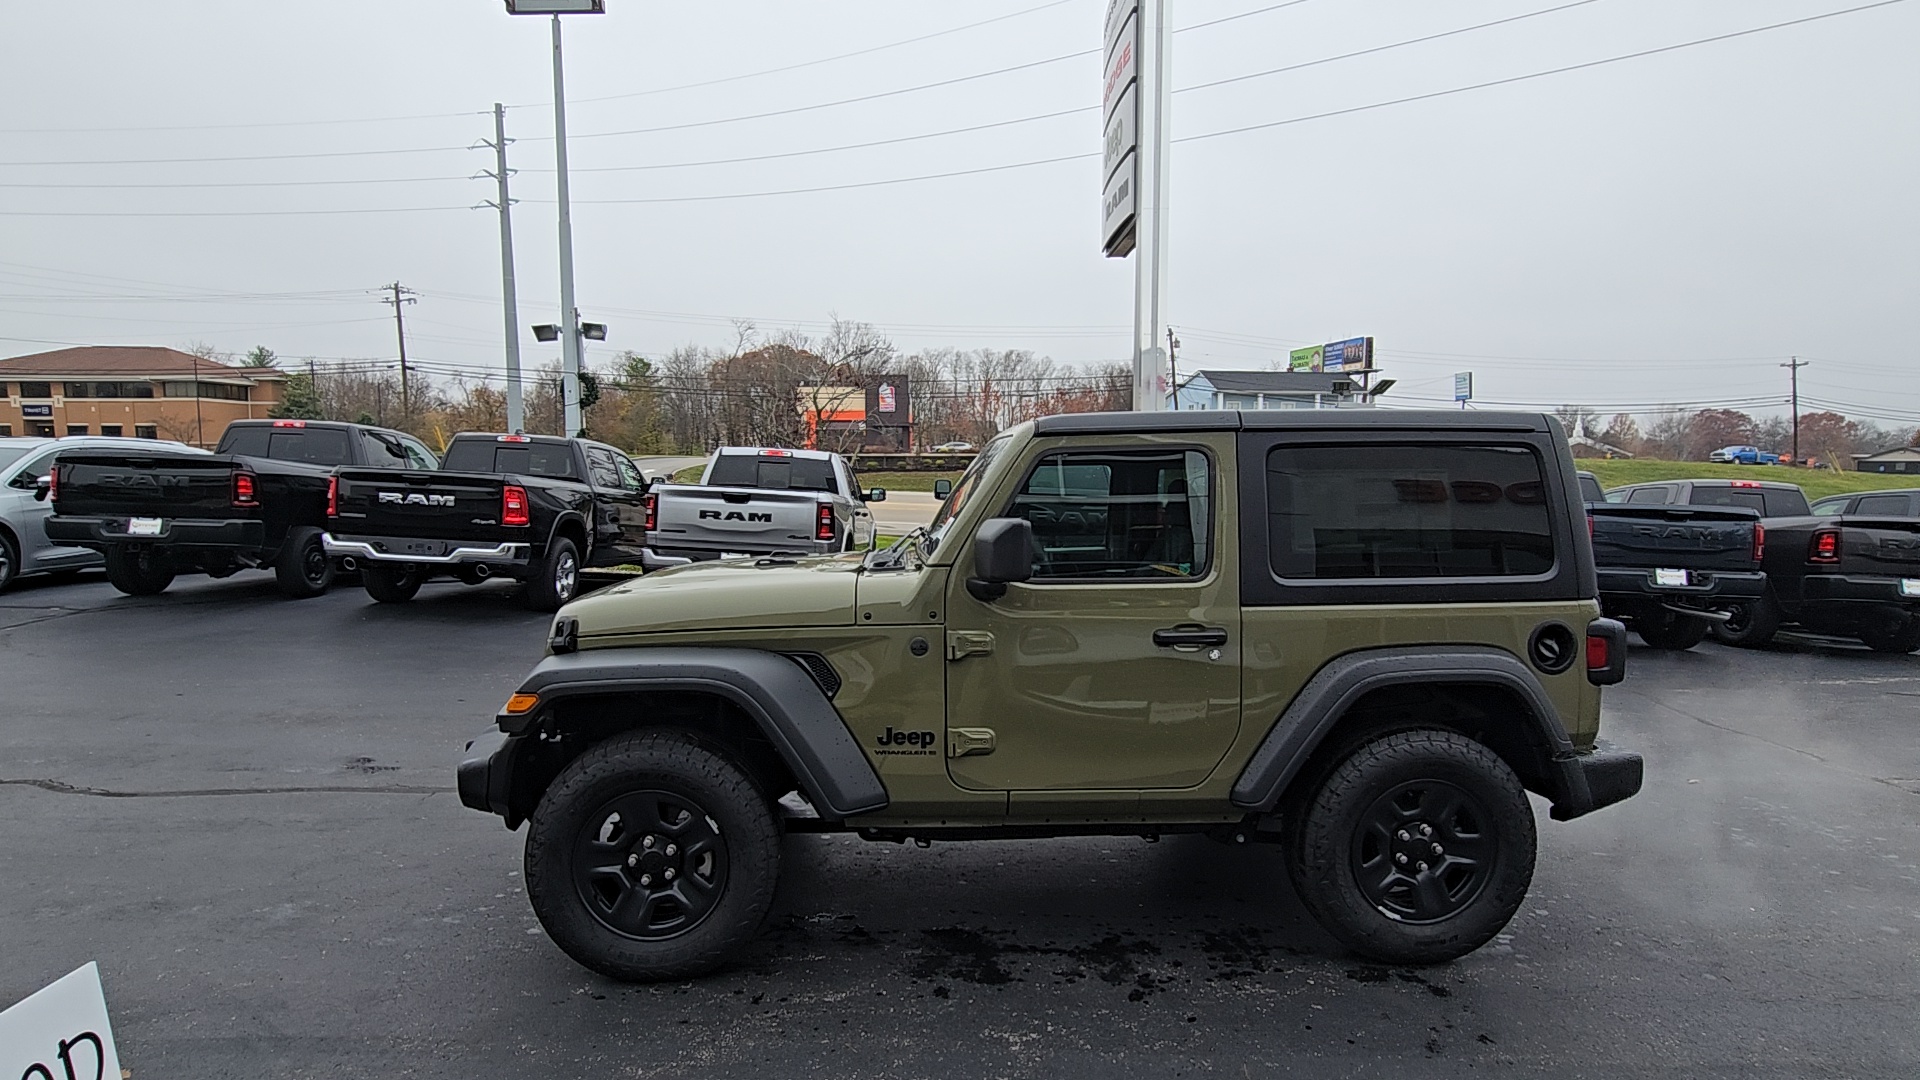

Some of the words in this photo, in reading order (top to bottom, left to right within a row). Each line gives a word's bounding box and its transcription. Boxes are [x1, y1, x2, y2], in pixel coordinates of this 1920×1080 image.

[97, 473, 190, 488] RAM
[378, 491, 456, 507] RAM
[699, 509, 773, 523] RAM
[1632, 525, 1720, 540] RAM
[877, 726, 935, 749] Jeep
